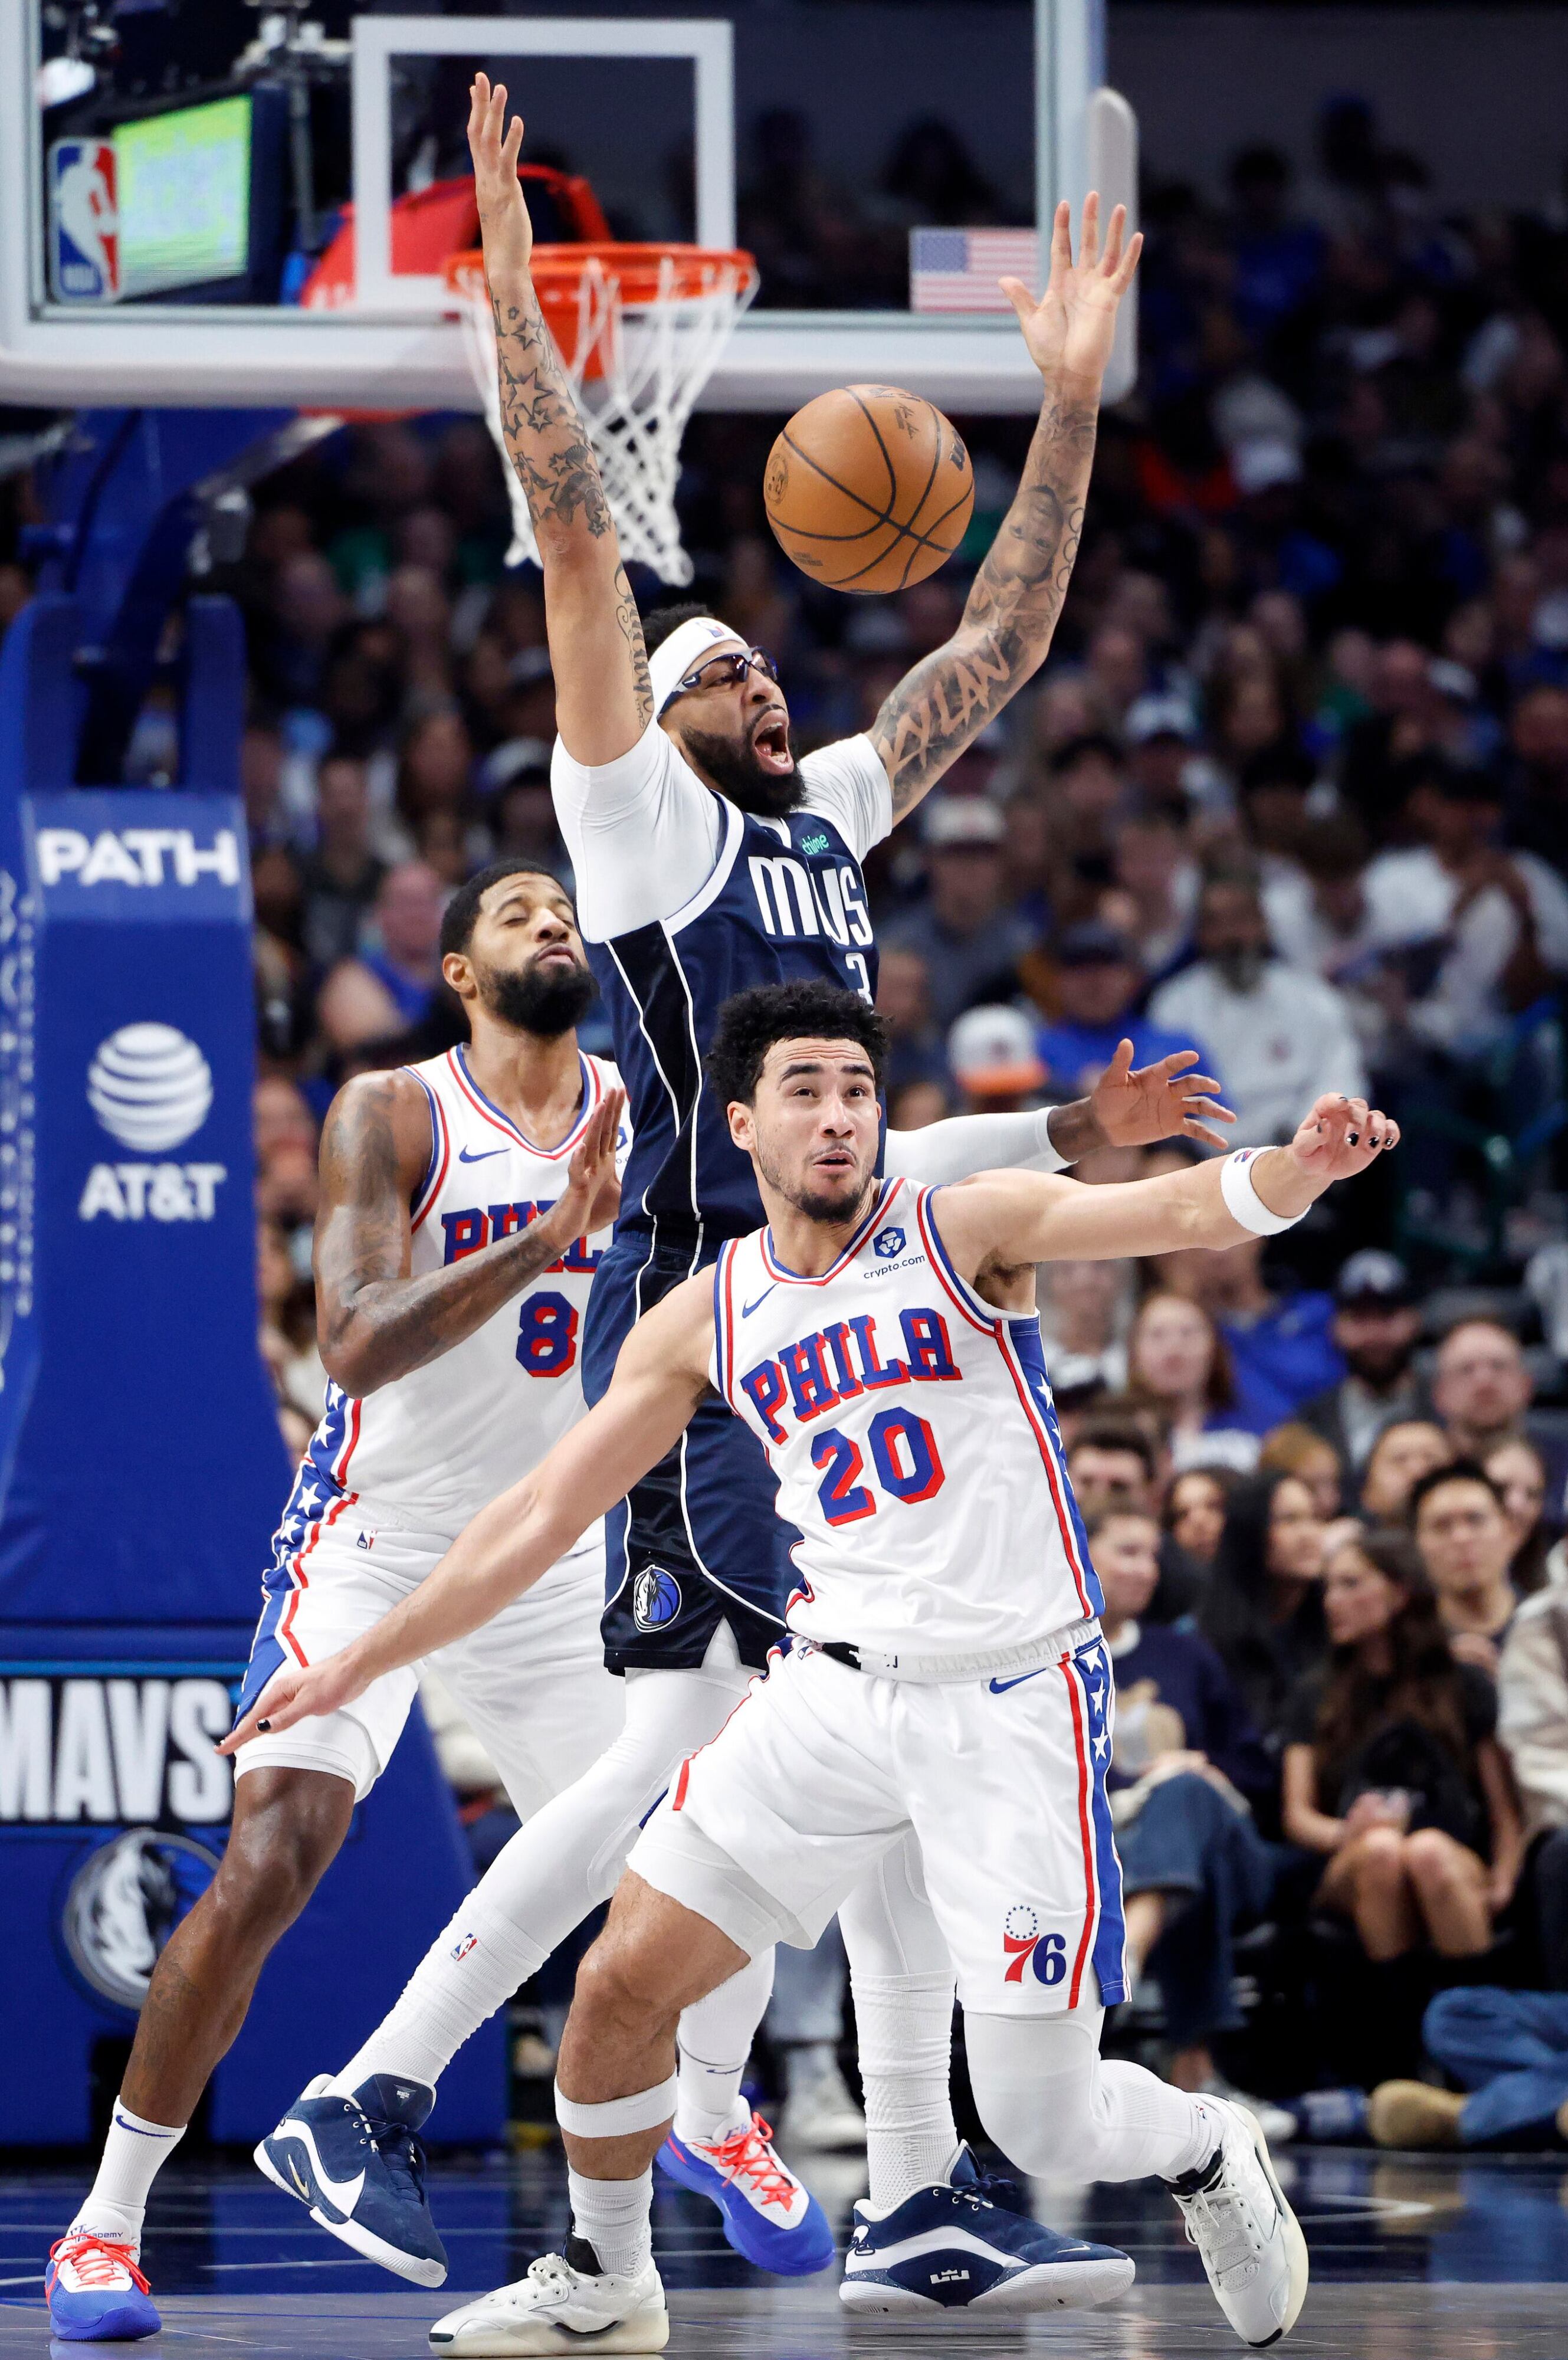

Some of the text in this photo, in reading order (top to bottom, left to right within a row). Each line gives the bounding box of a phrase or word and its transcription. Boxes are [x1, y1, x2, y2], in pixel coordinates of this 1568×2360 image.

[37, 828, 240, 886] PATH
[802, 834, 829, 855] chime
[79, 1163, 227, 1221] AT&T
[864, 1255, 925, 1279] crypto.com
[516, 1292, 579, 1377] 8
[740, 1308, 962, 1445] PHILA
[811, 1407, 945, 1527] 20
[0, 1679, 231, 1821] MAVS
[1003, 1932, 1067, 1985] 76
